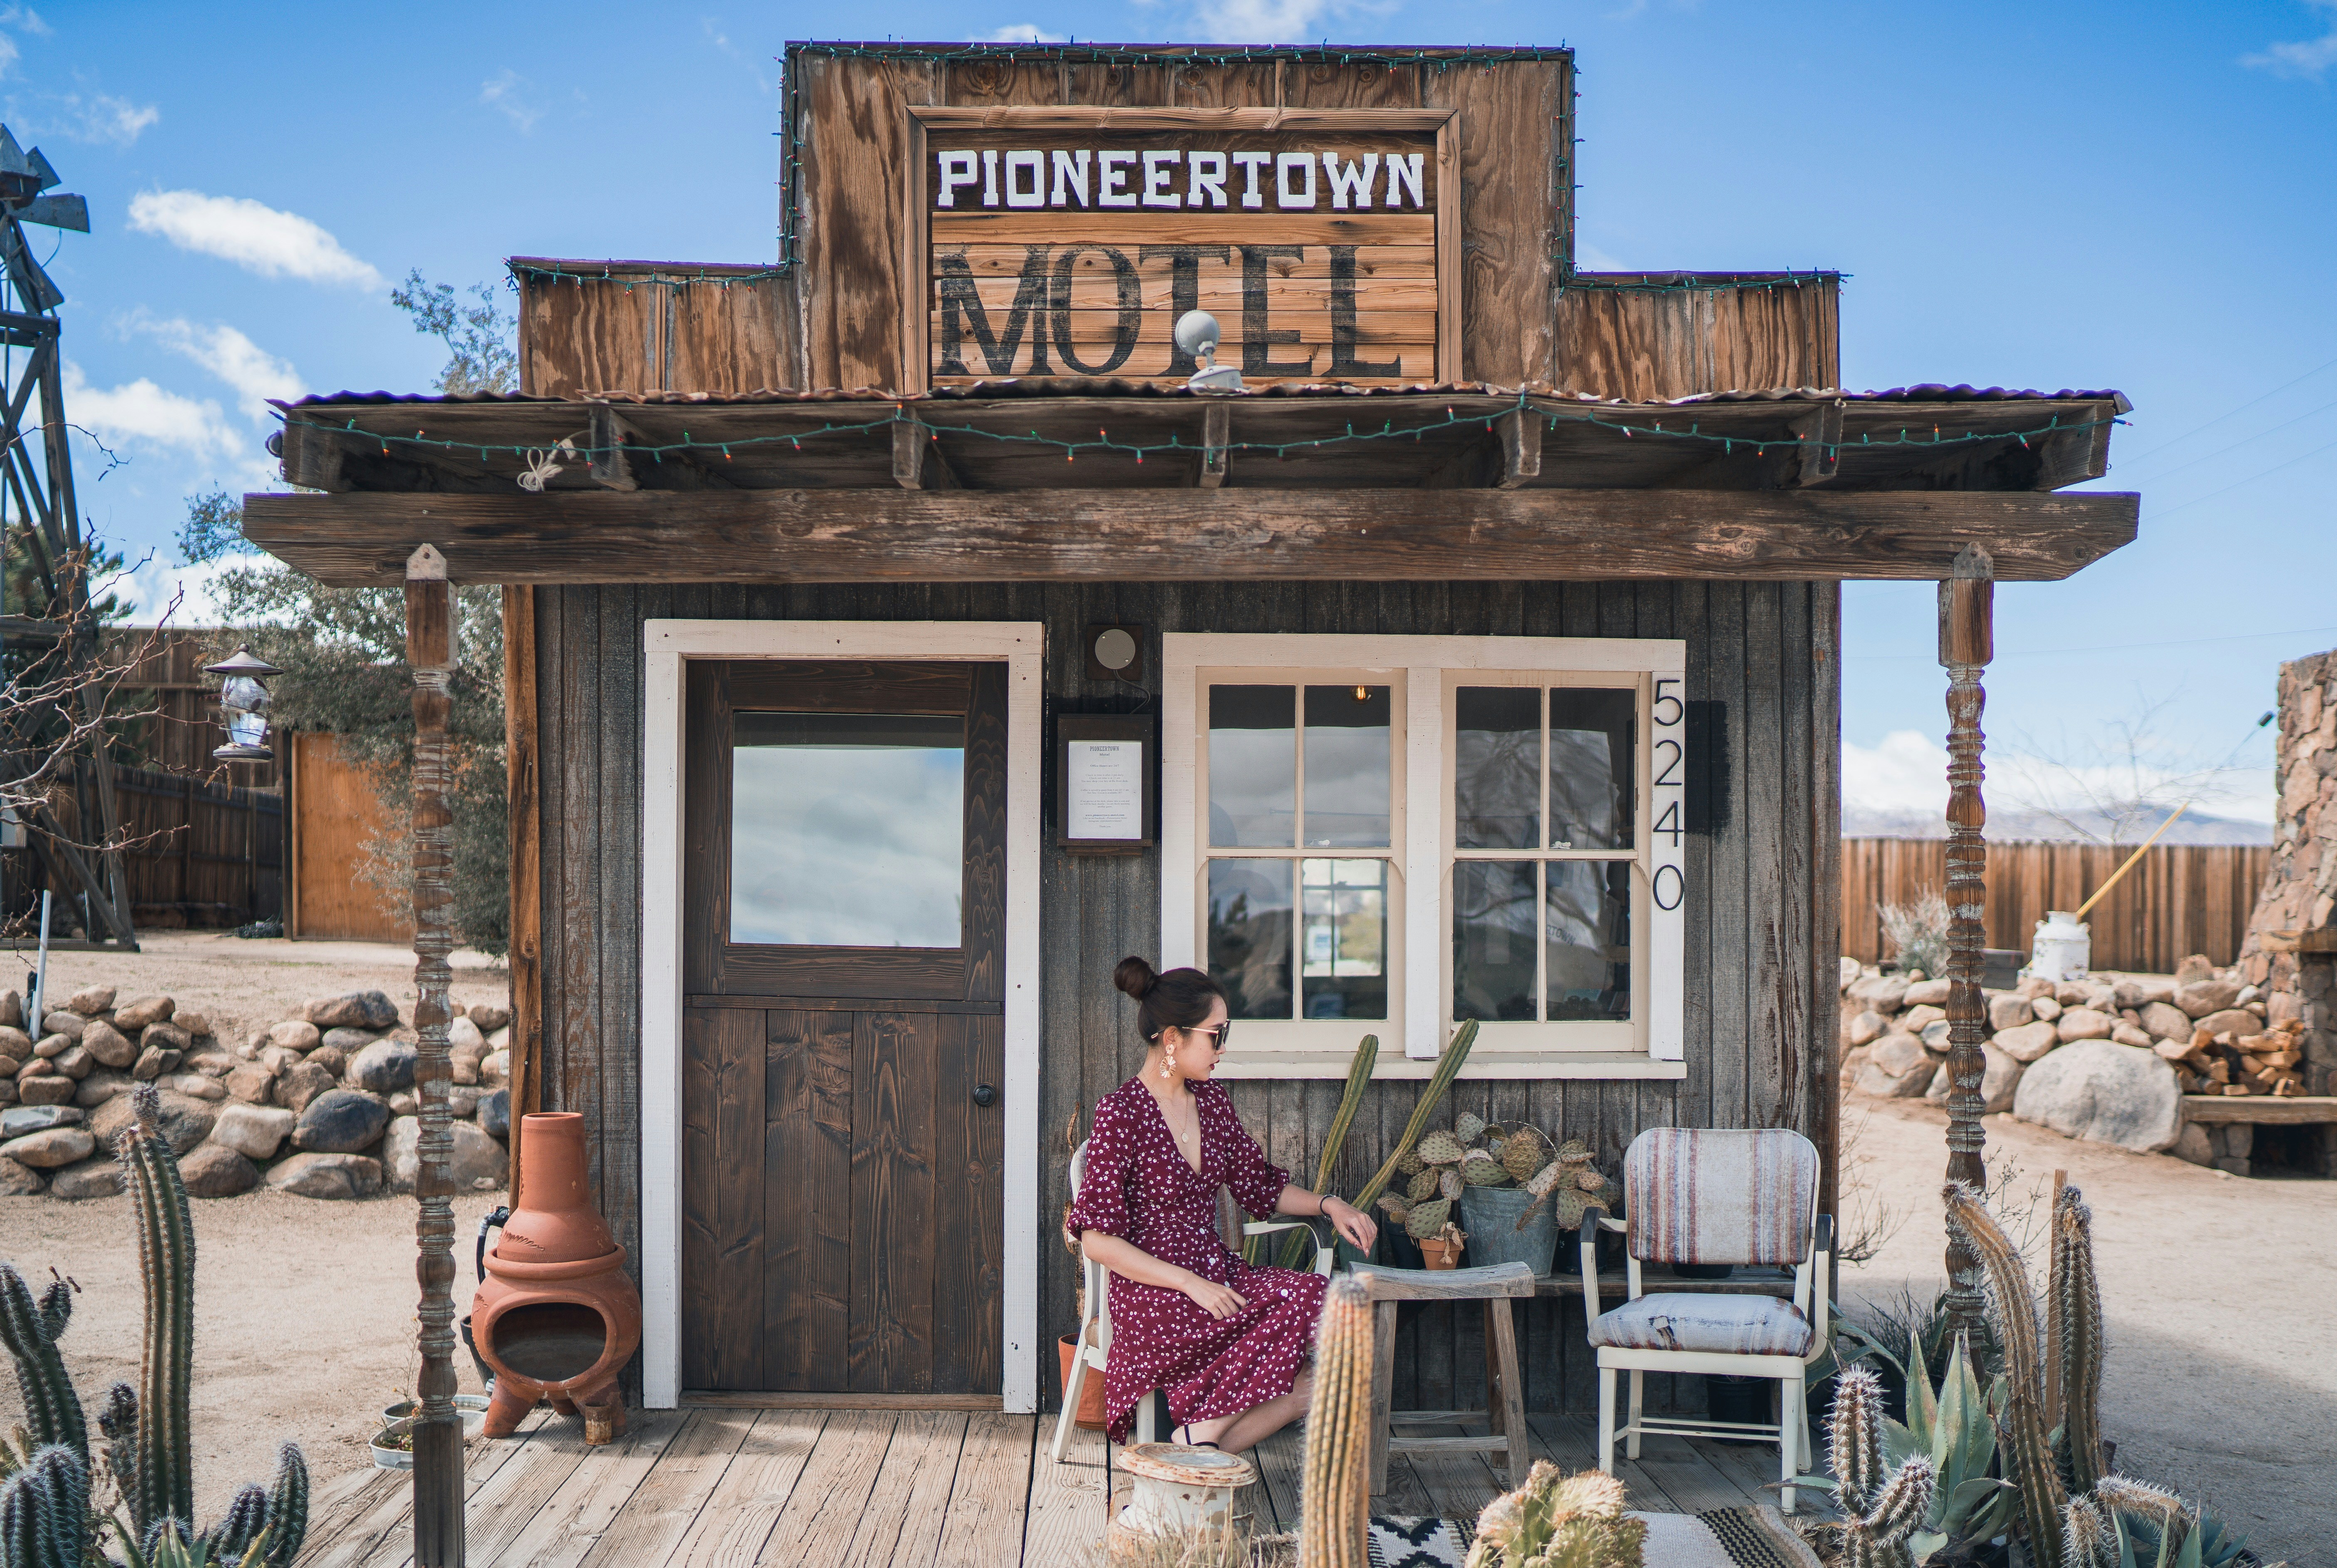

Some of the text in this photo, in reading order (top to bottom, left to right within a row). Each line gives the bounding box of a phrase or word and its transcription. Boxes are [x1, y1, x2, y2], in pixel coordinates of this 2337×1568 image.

[937, 149, 1425, 210] PIONEERTOWN
[933, 244, 1402, 377] MOTEL
[1652, 679, 1685, 911] 5240
